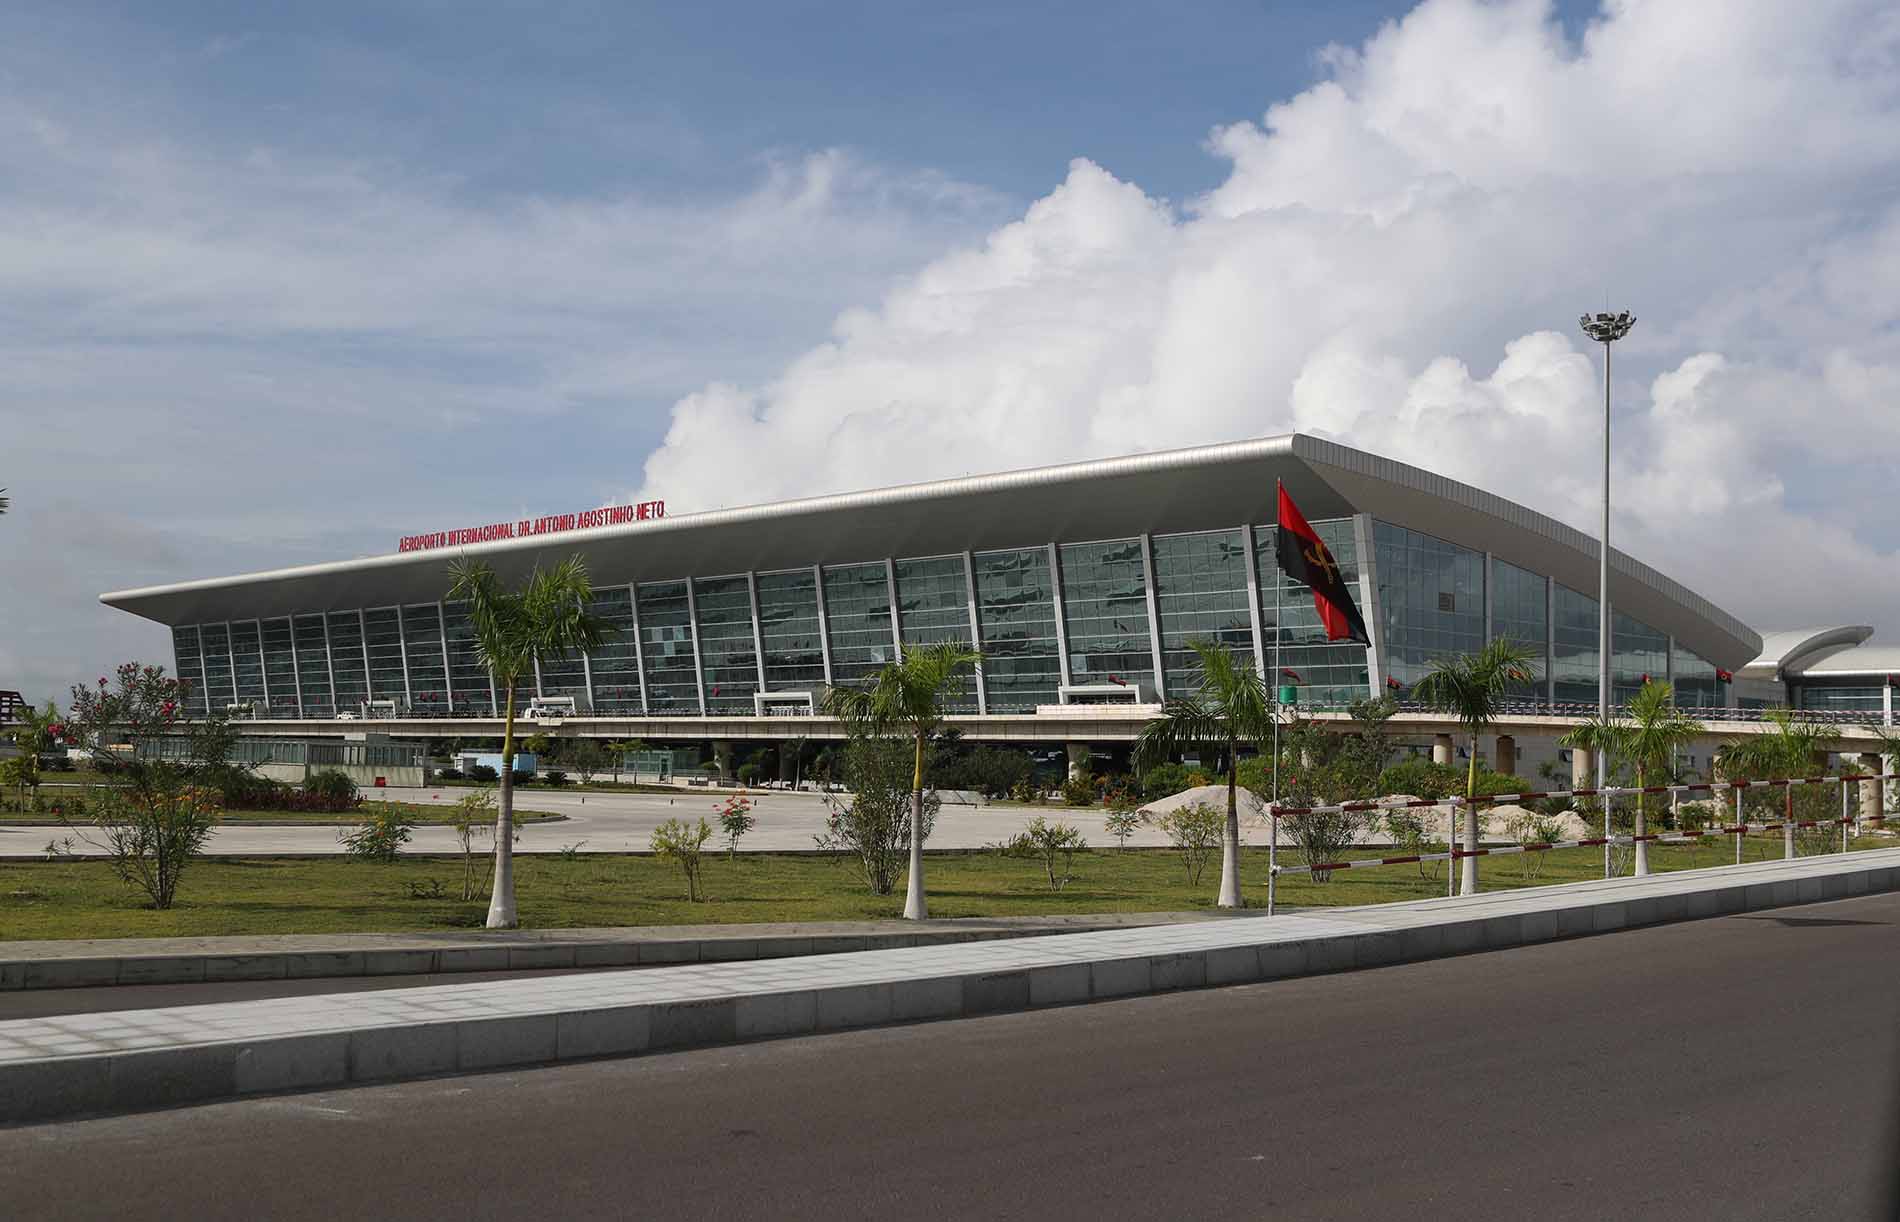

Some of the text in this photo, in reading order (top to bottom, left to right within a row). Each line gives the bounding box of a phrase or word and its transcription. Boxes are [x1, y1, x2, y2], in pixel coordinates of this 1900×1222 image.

[399, 532, 446, 552] AEROPORTO
[448, 523, 515, 546] INTERNACIONAL
[577, 505, 633, 529] AGOSTINHO
[636, 500, 665, 520] NETO
